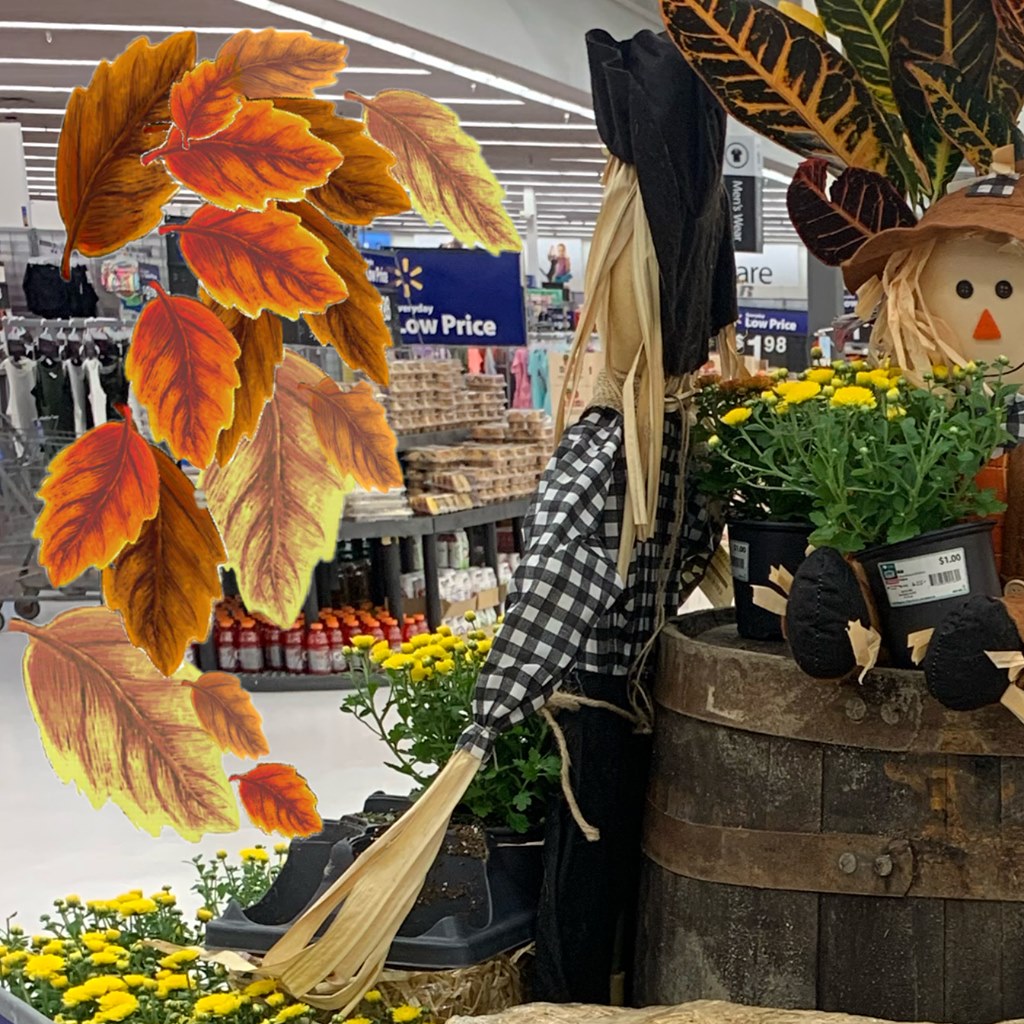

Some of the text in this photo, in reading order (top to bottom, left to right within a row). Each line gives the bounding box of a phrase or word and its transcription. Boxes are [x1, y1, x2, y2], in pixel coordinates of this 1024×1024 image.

[732, 180, 744, 242] Men's Wear
[397, 303, 434, 316] veryday
[400, 313, 497, 337] ow Price
[745, 317, 798, 332] Low Price
[938, 553, 962, 566] $1.00
